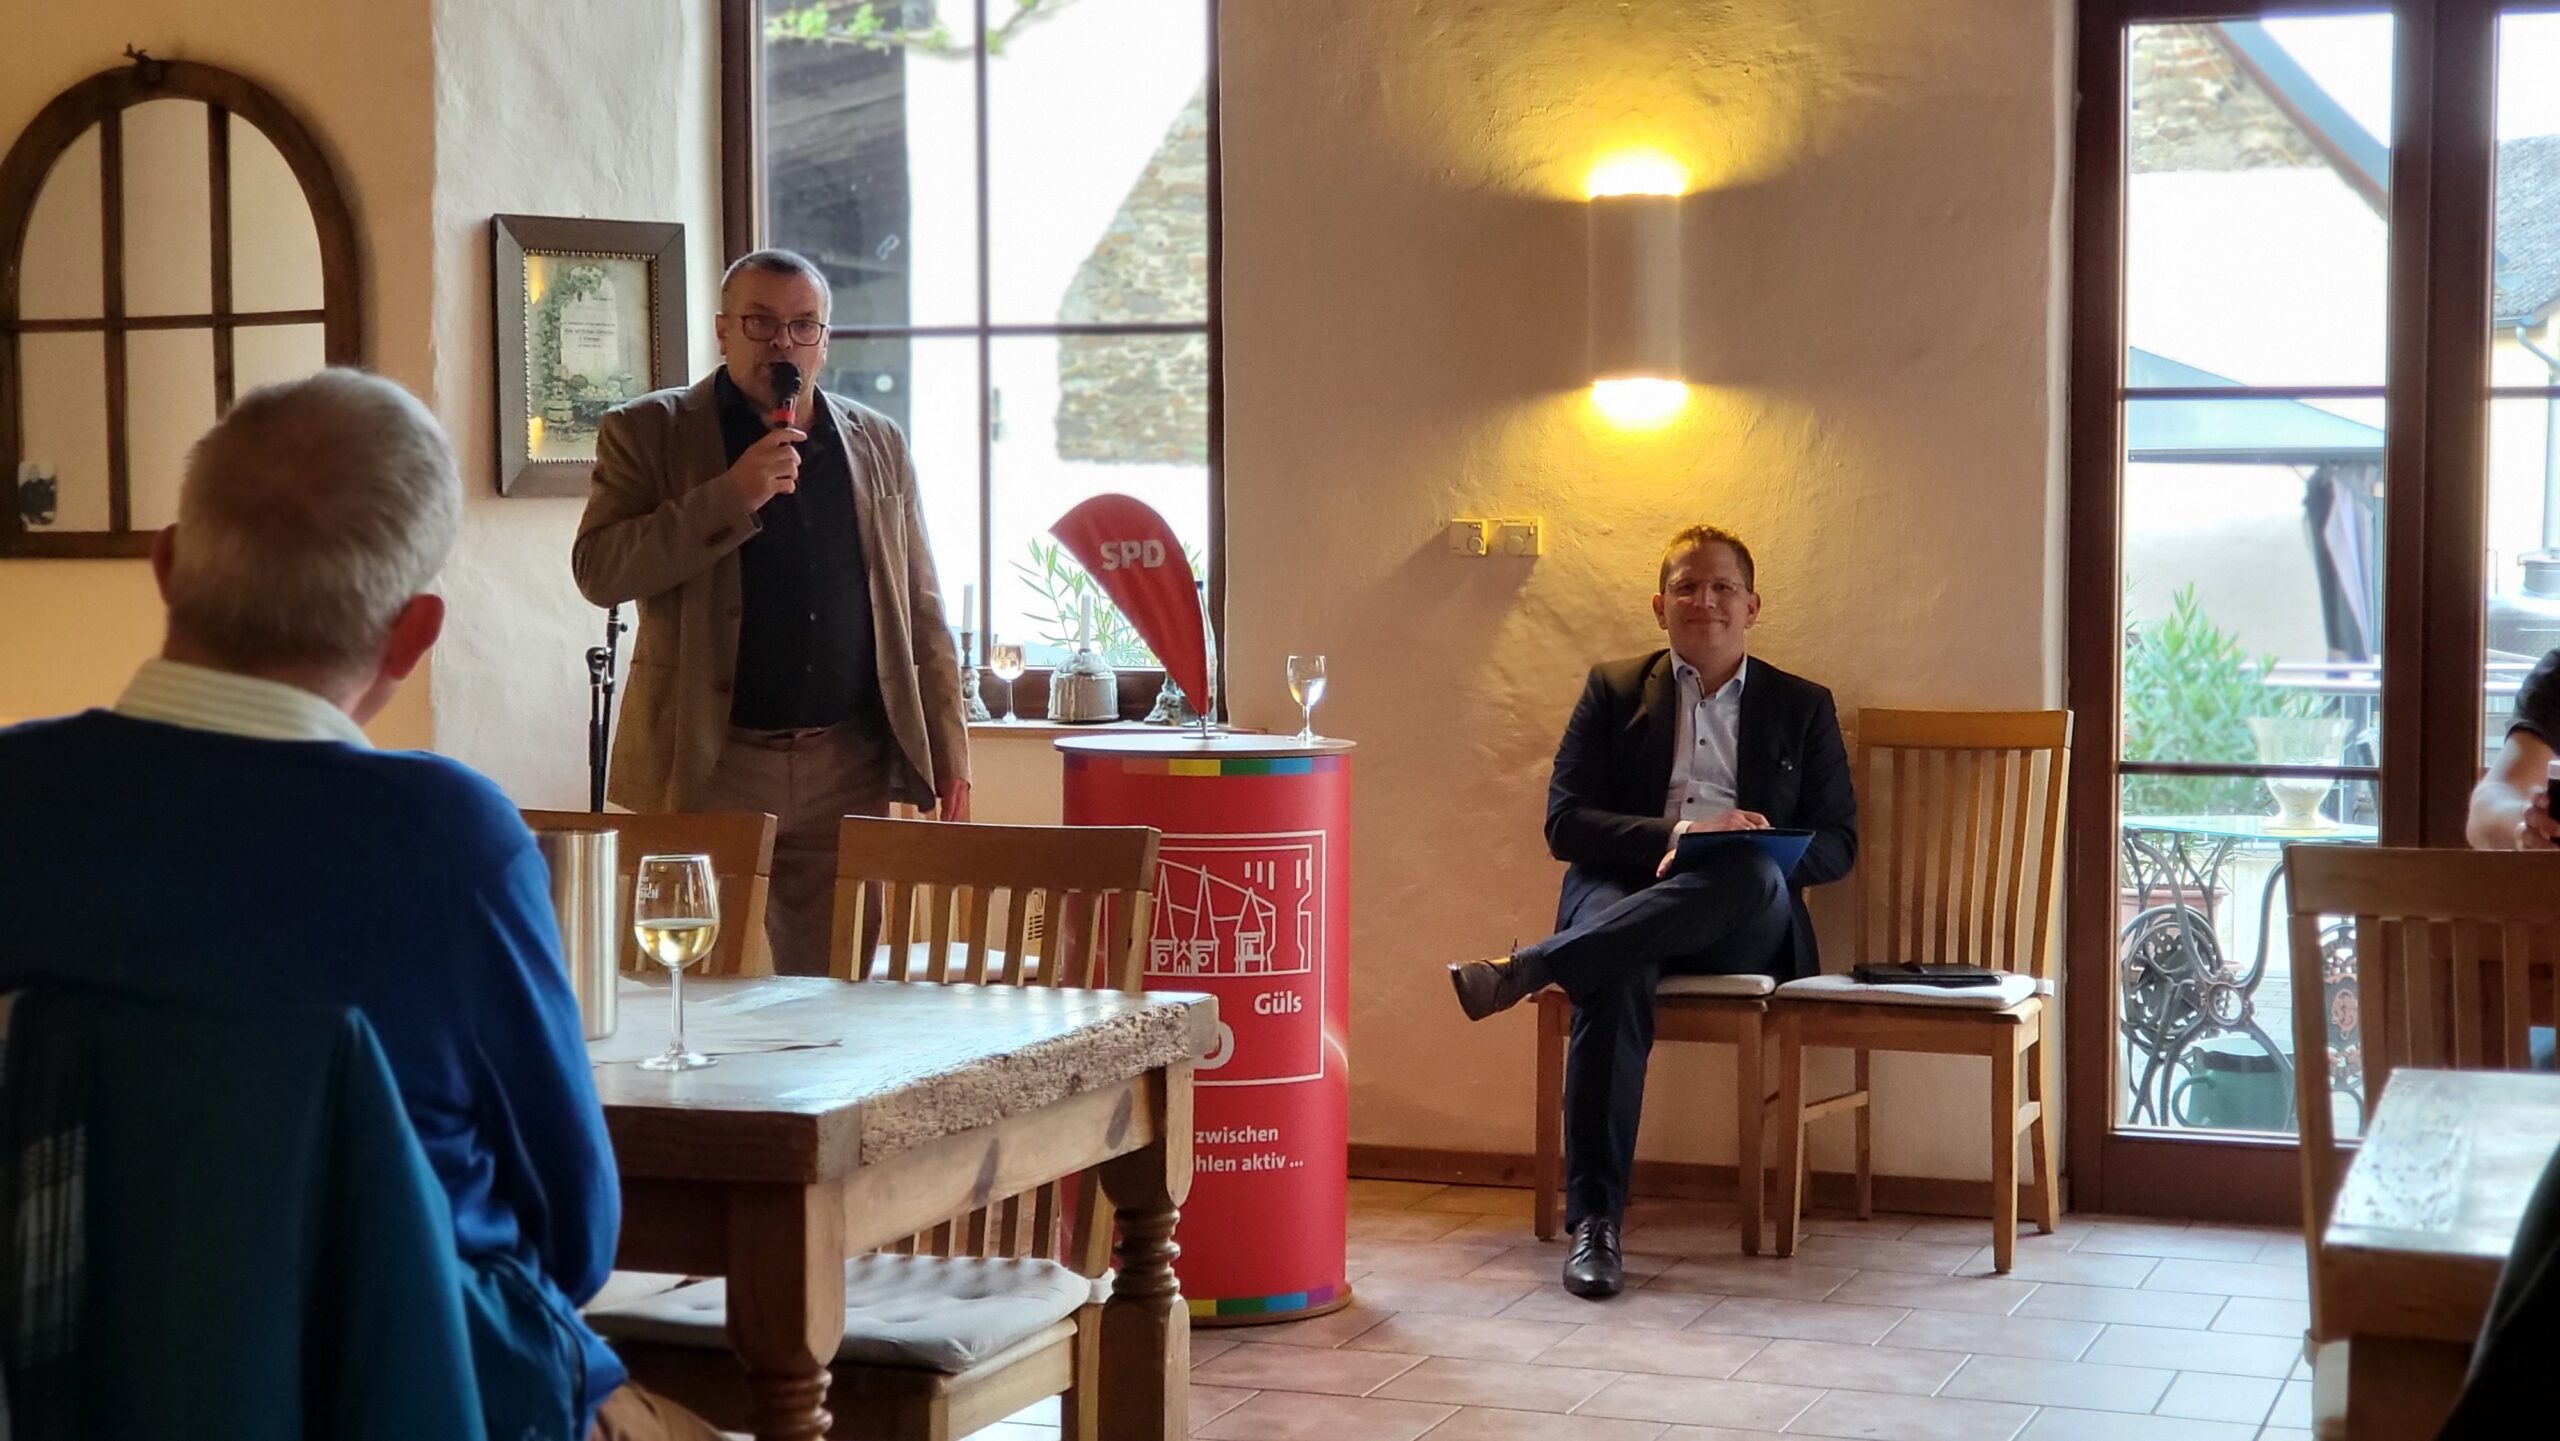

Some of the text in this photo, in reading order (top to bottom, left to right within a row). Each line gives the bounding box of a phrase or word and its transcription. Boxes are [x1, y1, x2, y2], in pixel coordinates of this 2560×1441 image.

[1100, 539, 1166, 571] SPD
[1254, 990, 1302, 1015] Güls
[1195, 1125, 1279, 1144] zwischen
[1195, 1154, 1236, 1172] hlen
[1241, 1151, 1286, 1171] aktiv
